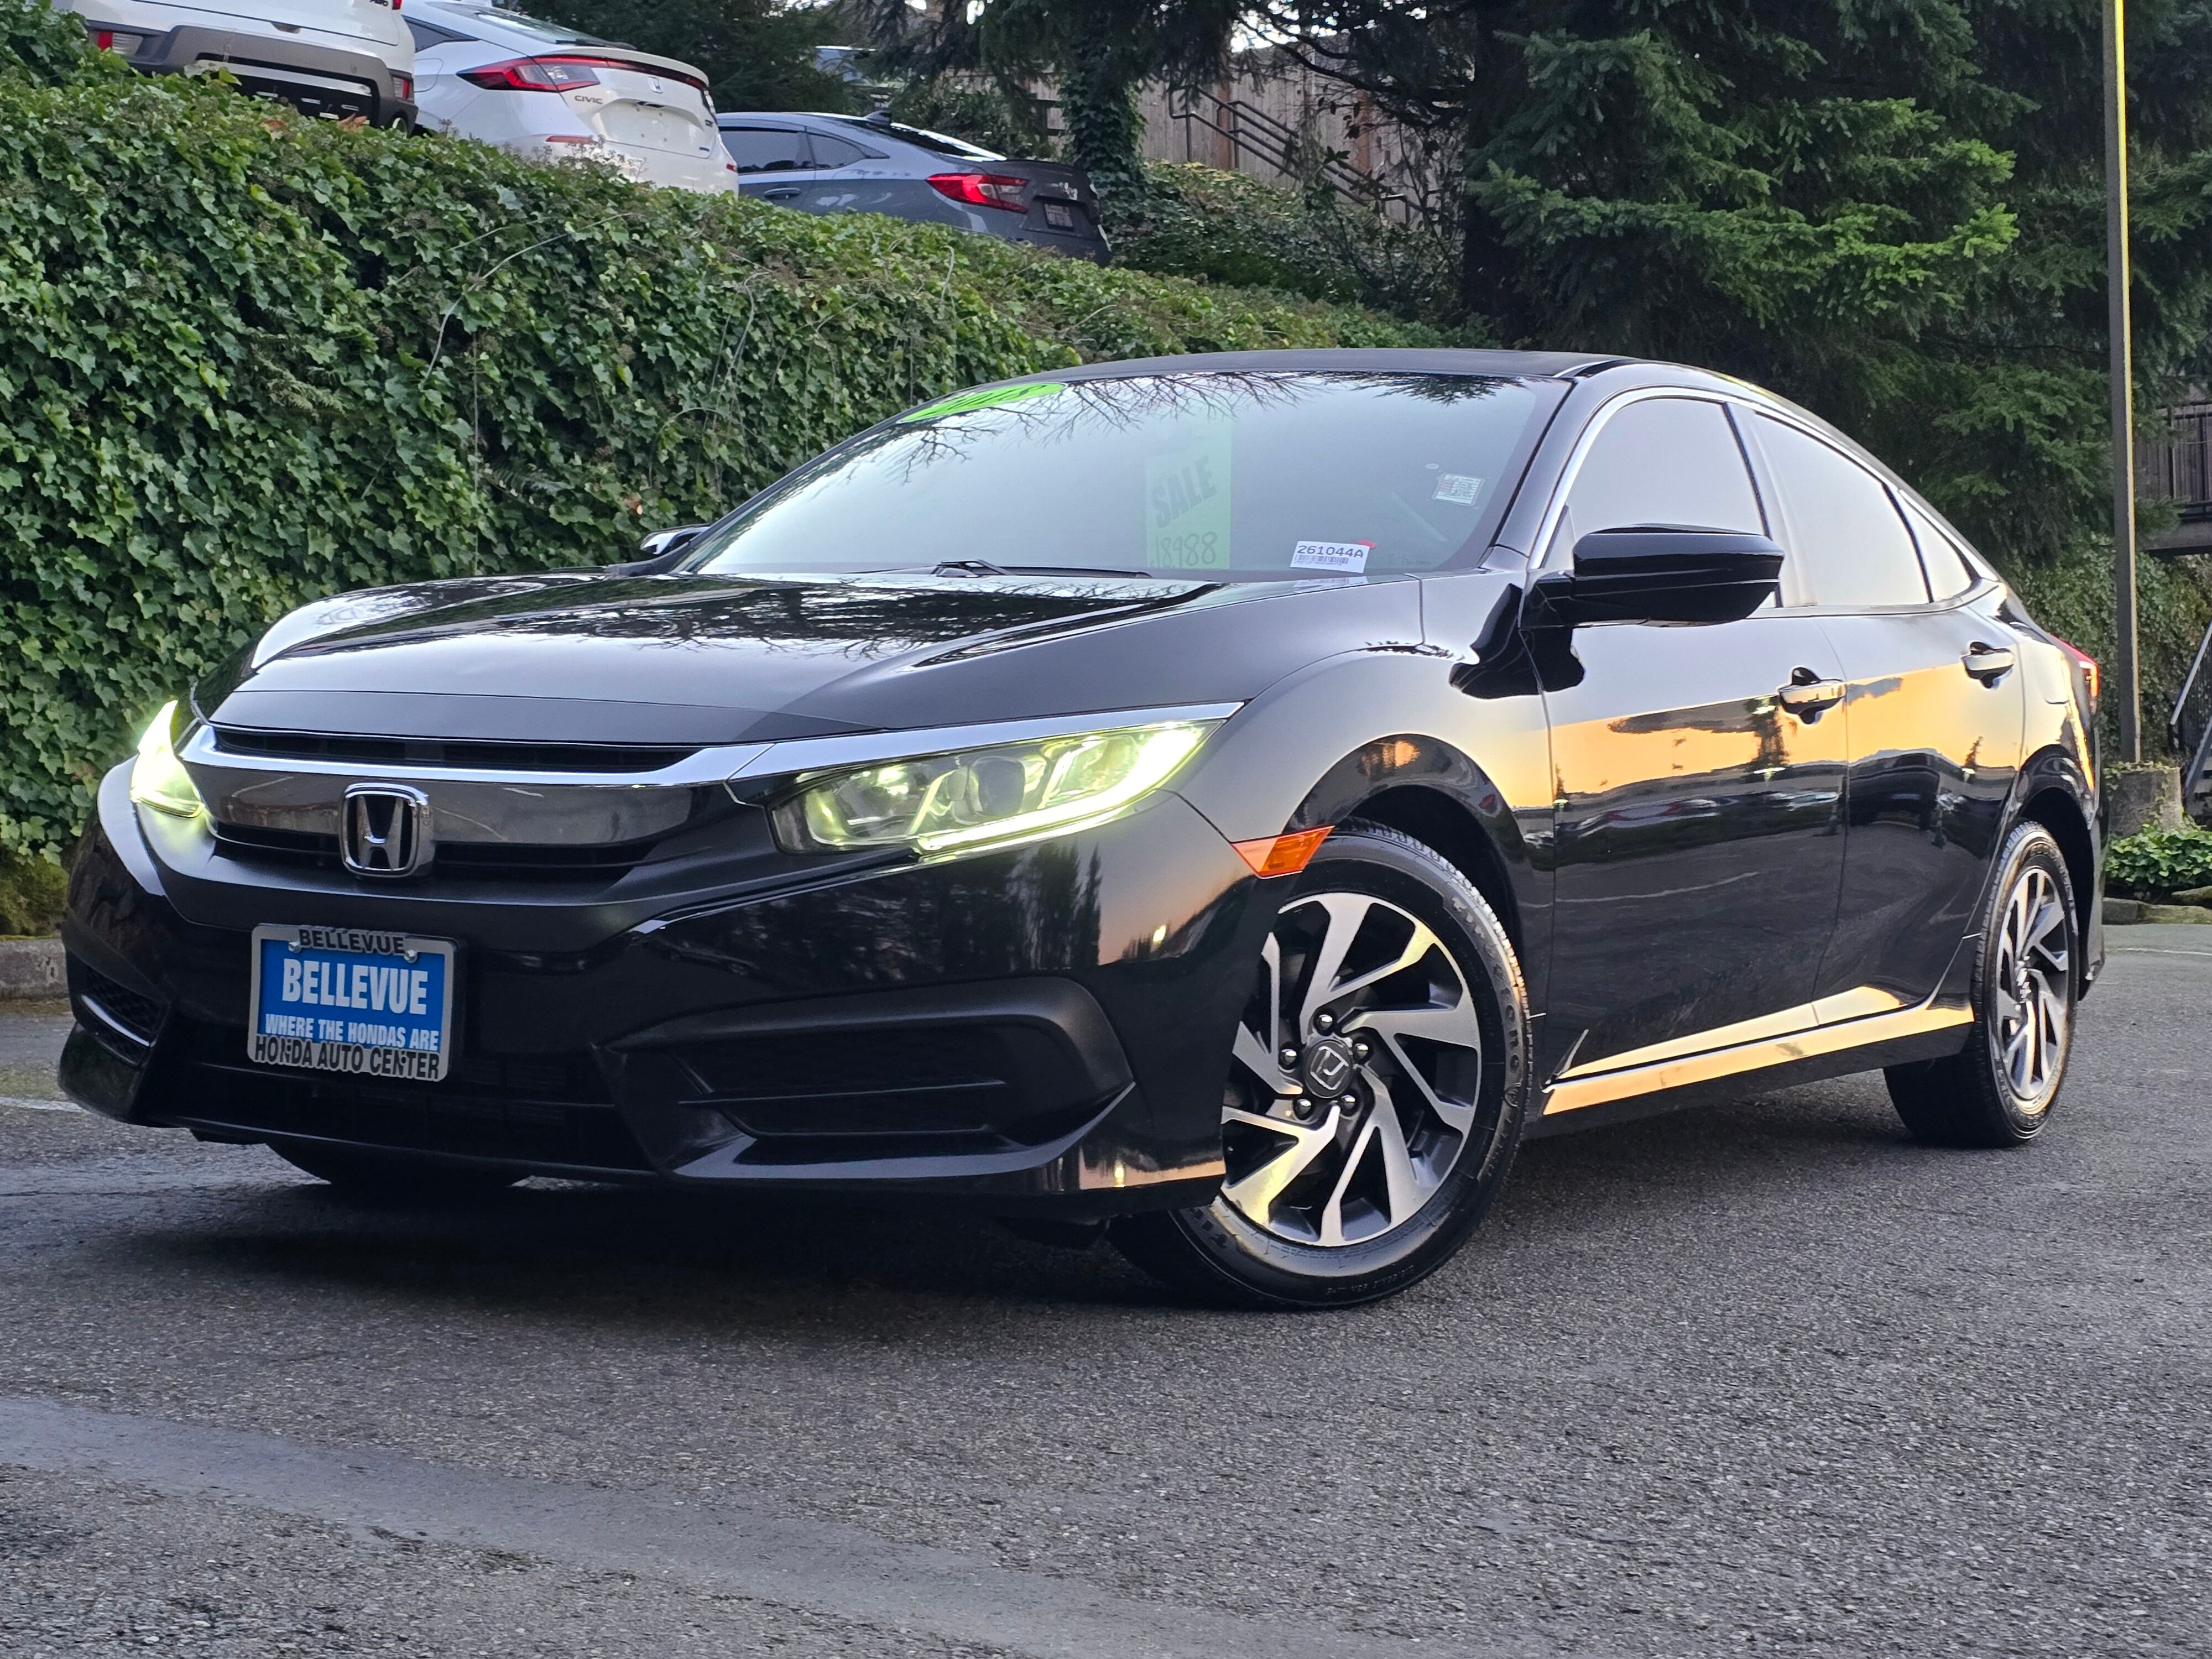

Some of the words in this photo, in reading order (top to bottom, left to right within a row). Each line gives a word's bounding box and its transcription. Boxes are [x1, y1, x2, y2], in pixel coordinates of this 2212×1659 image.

[575, 95, 603, 105] CIVIC
[1151, 455, 1218, 529] SALE
[1297, 545, 1364, 559] 261044A
[299, 928, 405, 954] BELLEVUE
[282, 958, 428, 1015] BELLEVUE
[265, 1013, 315, 1039] WHERE
[318, 1019, 344, 1041] THE
[347, 1021, 406, 1048] HONDAS
[409, 1028, 439, 1051] ARE
[254, 1035, 313, 1066] HONDA
[317, 1042, 364, 1072] AUTO
[369, 1047, 440, 1079] CENTER
